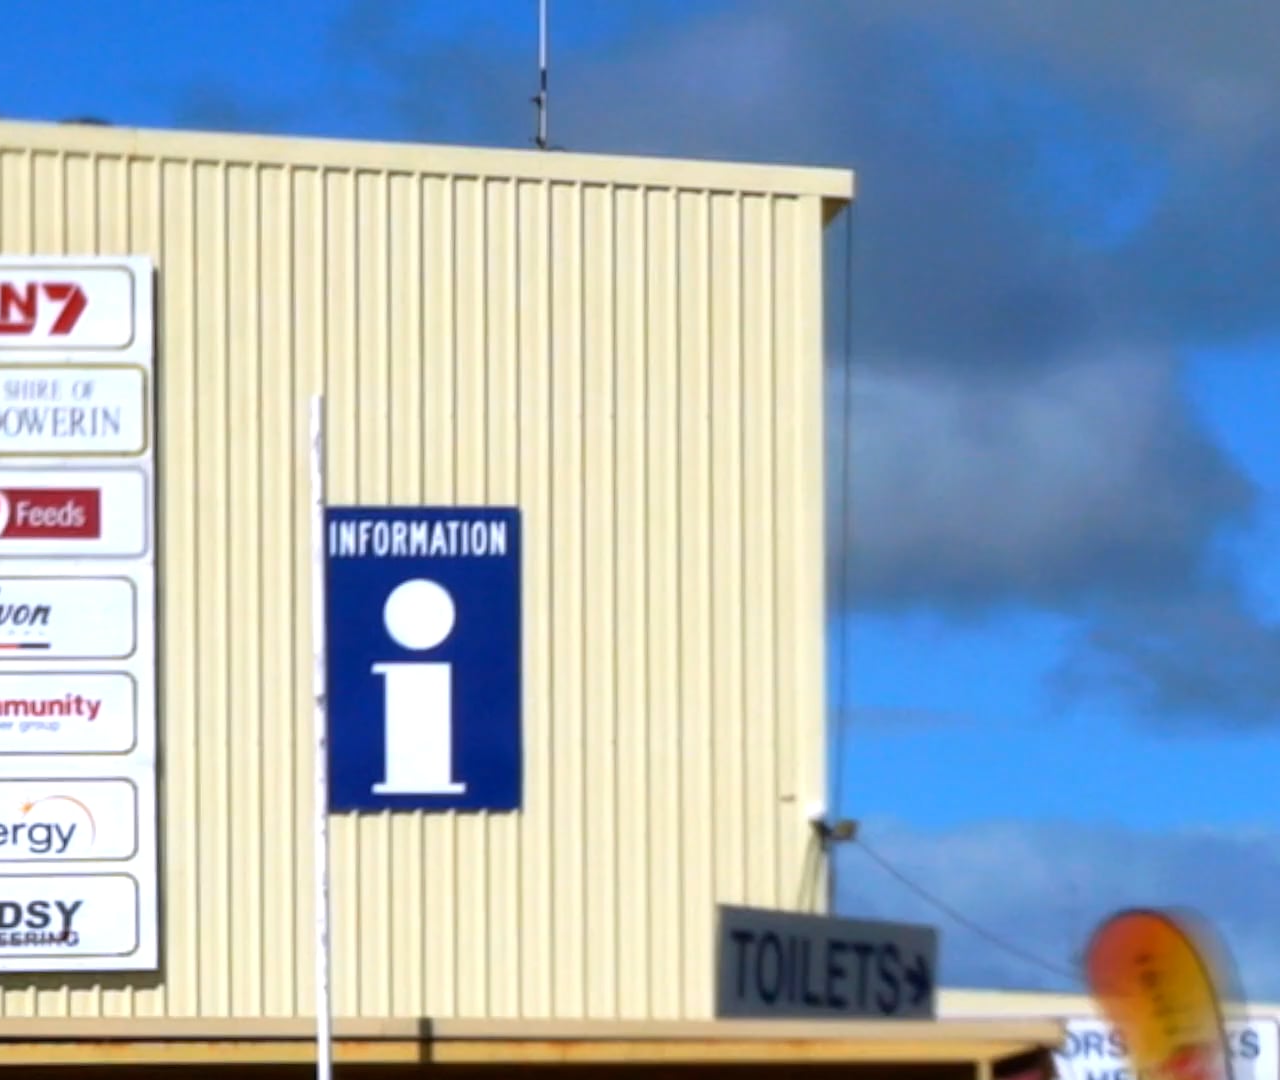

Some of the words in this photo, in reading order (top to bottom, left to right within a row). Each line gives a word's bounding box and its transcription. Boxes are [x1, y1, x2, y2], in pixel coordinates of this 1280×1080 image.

[3, 379, 61, 400] SHIRE
[72, 379, 95, 400] OF
[16, 501, 85, 527] Feeds
[329, 520, 508, 556] INFORMATION
[730, 929, 901, 1014] TOILETS
